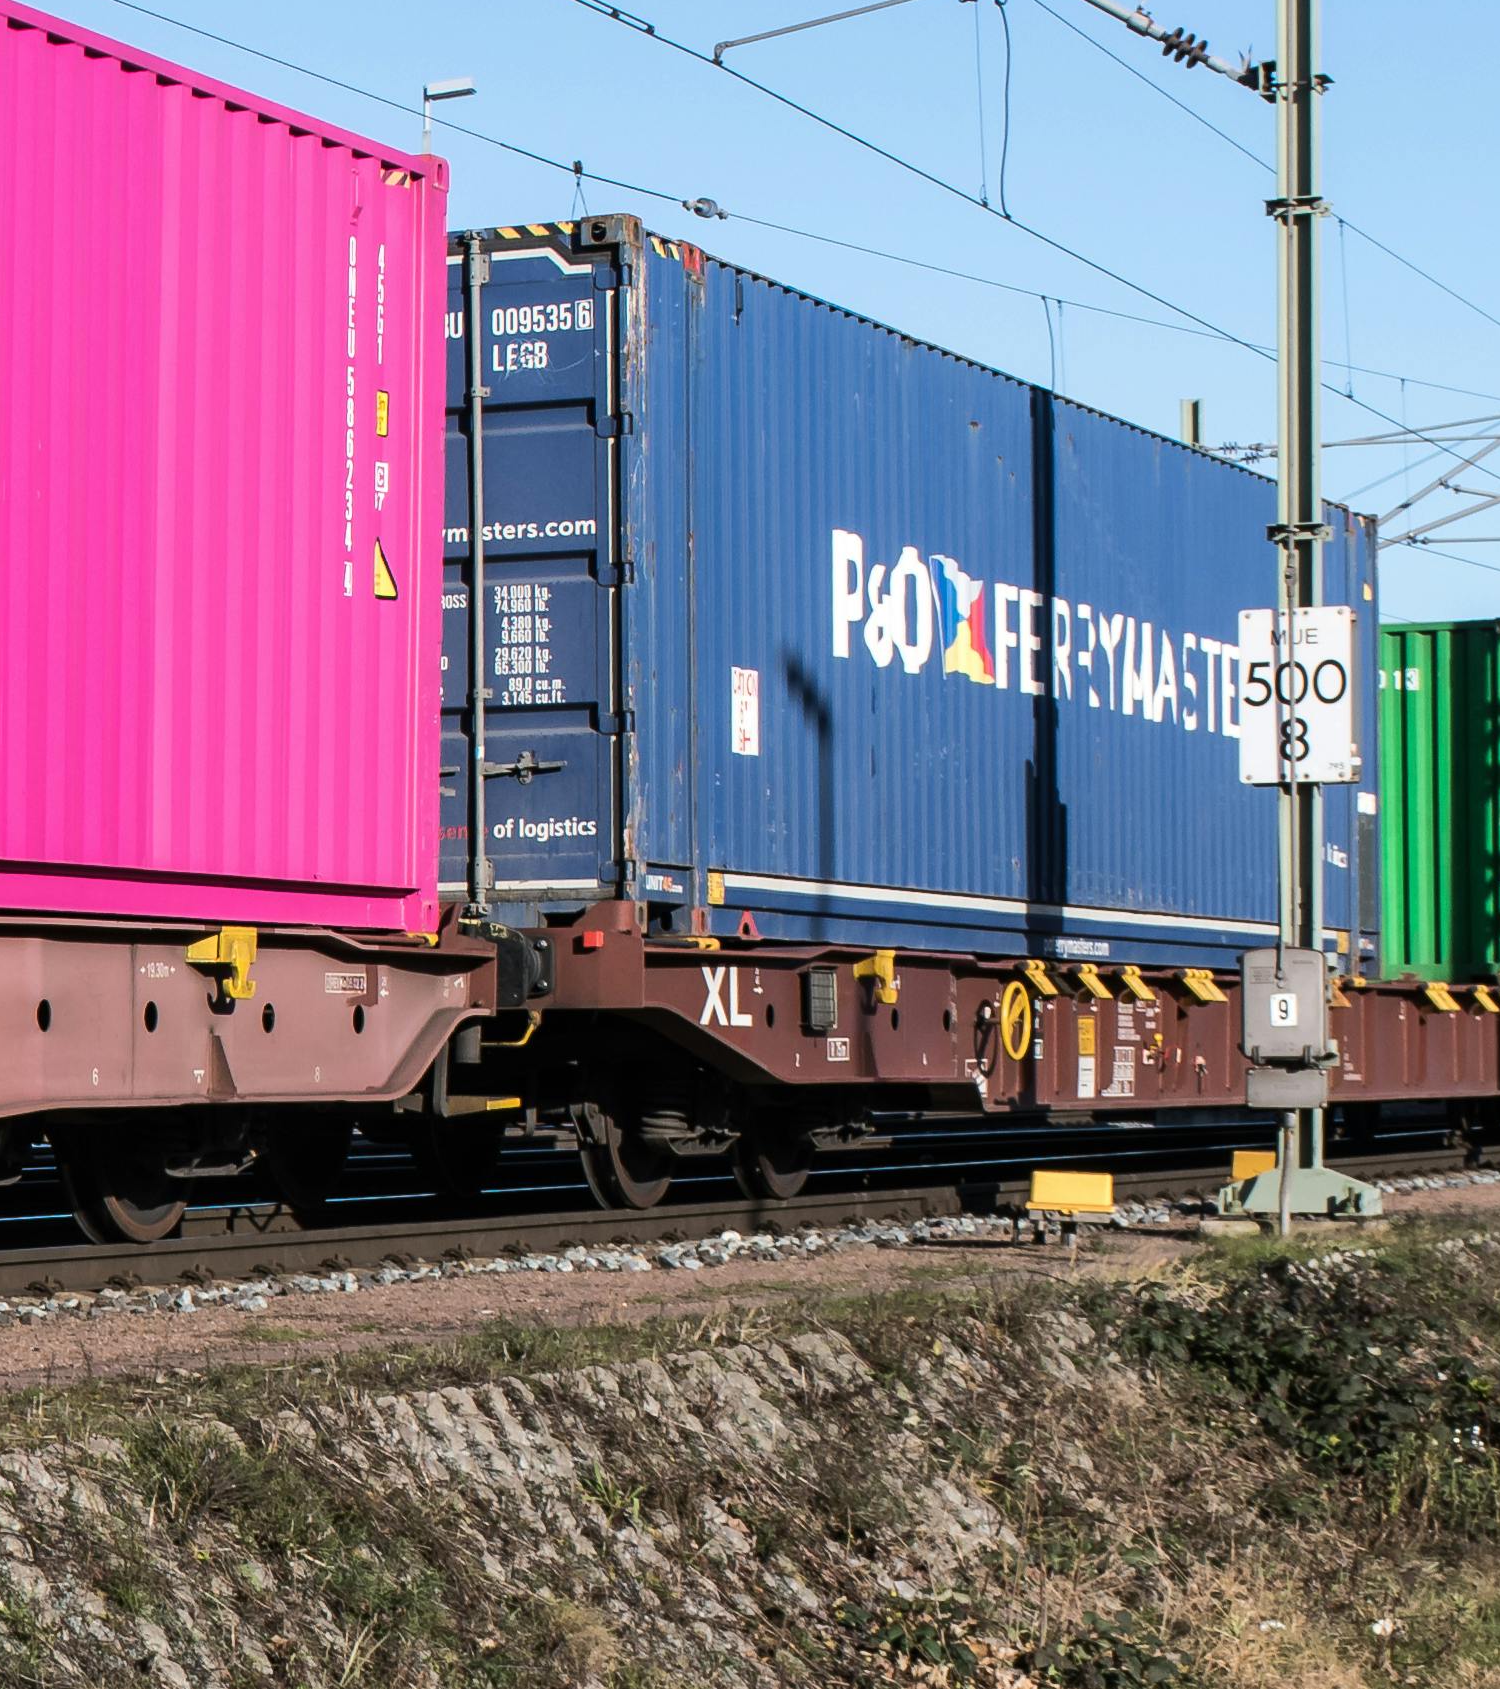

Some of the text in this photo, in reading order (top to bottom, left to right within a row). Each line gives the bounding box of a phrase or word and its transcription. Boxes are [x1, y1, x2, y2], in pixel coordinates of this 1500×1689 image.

[491, 302, 573, 336] 009535
[576, 299, 593, 330] 6
[494, 584, 553, 601] 34.000 kg.
[494, 599, 550, 614] 74.960 lb.
[501, 615, 553, 631] 4.380 kg.
[501, 629, 550, 644] 9.660 lb.
[831, 527, 1240, 740] P&O FERRYMASTE
[494, 646, 553, 662] 29.620 kg.
[535, 660, 550, 673] lb.
[508, 677, 533, 692] 89.0
[1243, 658, 1347, 707] 500
[1279, 716, 1310, 762] 8
[493, 817, 515, 839] of
[518, 817, 597, 842] logistics
[699, 965, 753, 1027] XL
[1278, 999, 1289, 1020] 9
[92, 1067, 99, 1086] 6
[314, 1066, 320, 1082] 8
